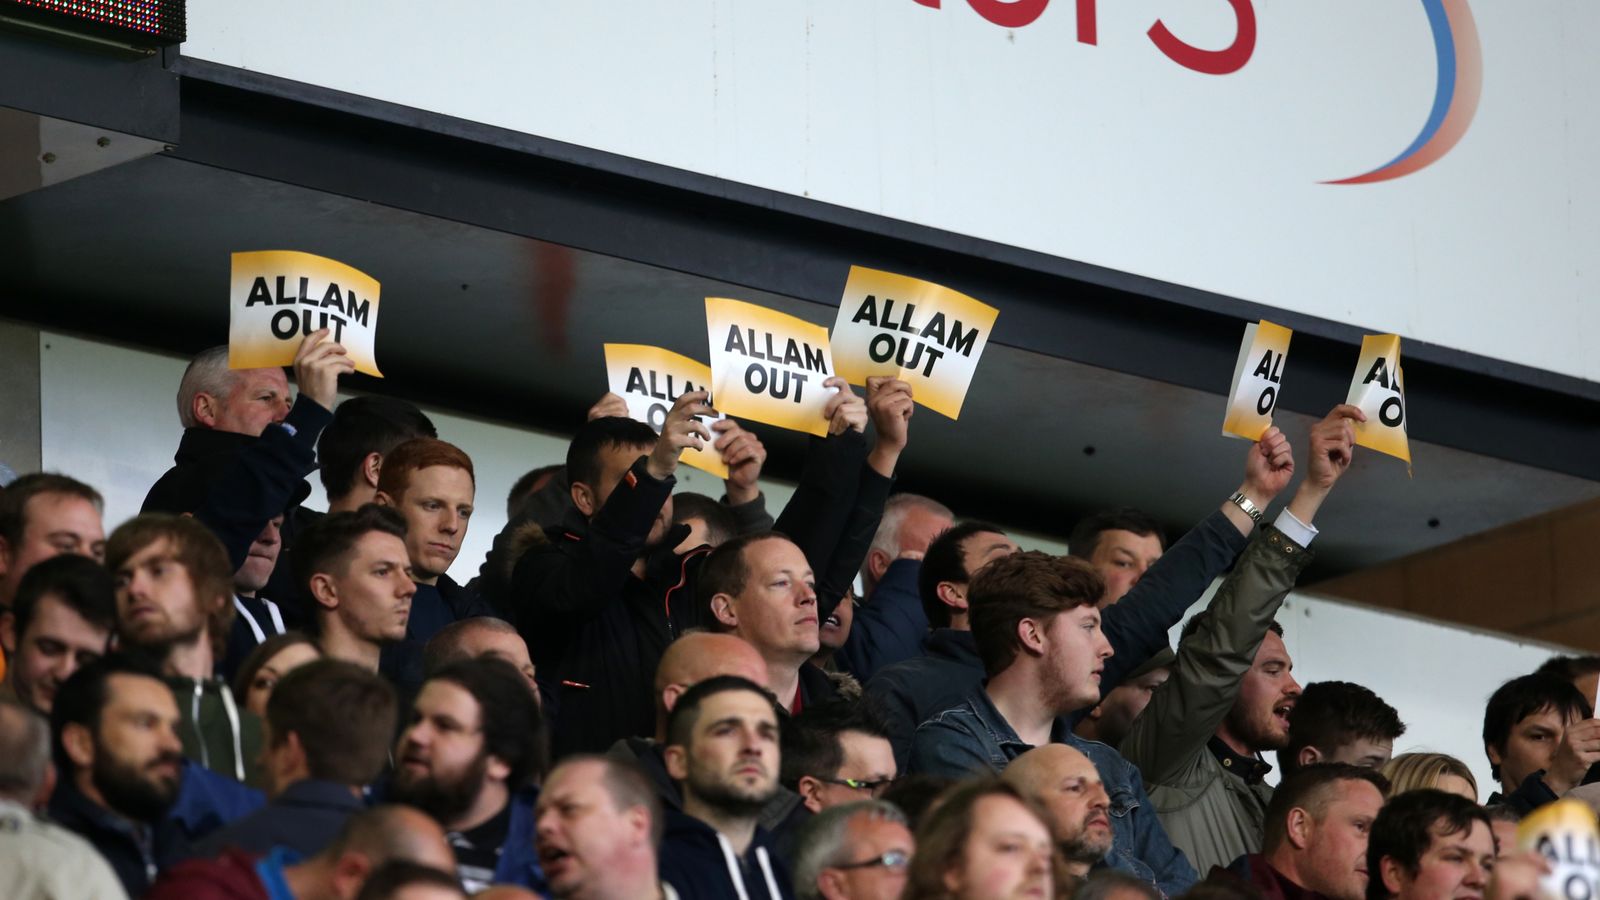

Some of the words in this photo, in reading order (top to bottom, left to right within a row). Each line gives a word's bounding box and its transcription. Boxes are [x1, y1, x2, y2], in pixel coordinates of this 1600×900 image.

[246, 276, 370, 328] ALLAM
[271, 309, 347, 343] OUT
[852, 294, 979, 358] ALLAM
[724, 324, 828, 375] ALLAM
[869, 333, 944, 378] OUT
[1253, 349, 1282, 384] AL
[744, 362, 808, 403] OUT
[1257, 386, 1276, 416] O
[1378, 396, 1403, 428] O
[1563, 872, 1594, 900] O
